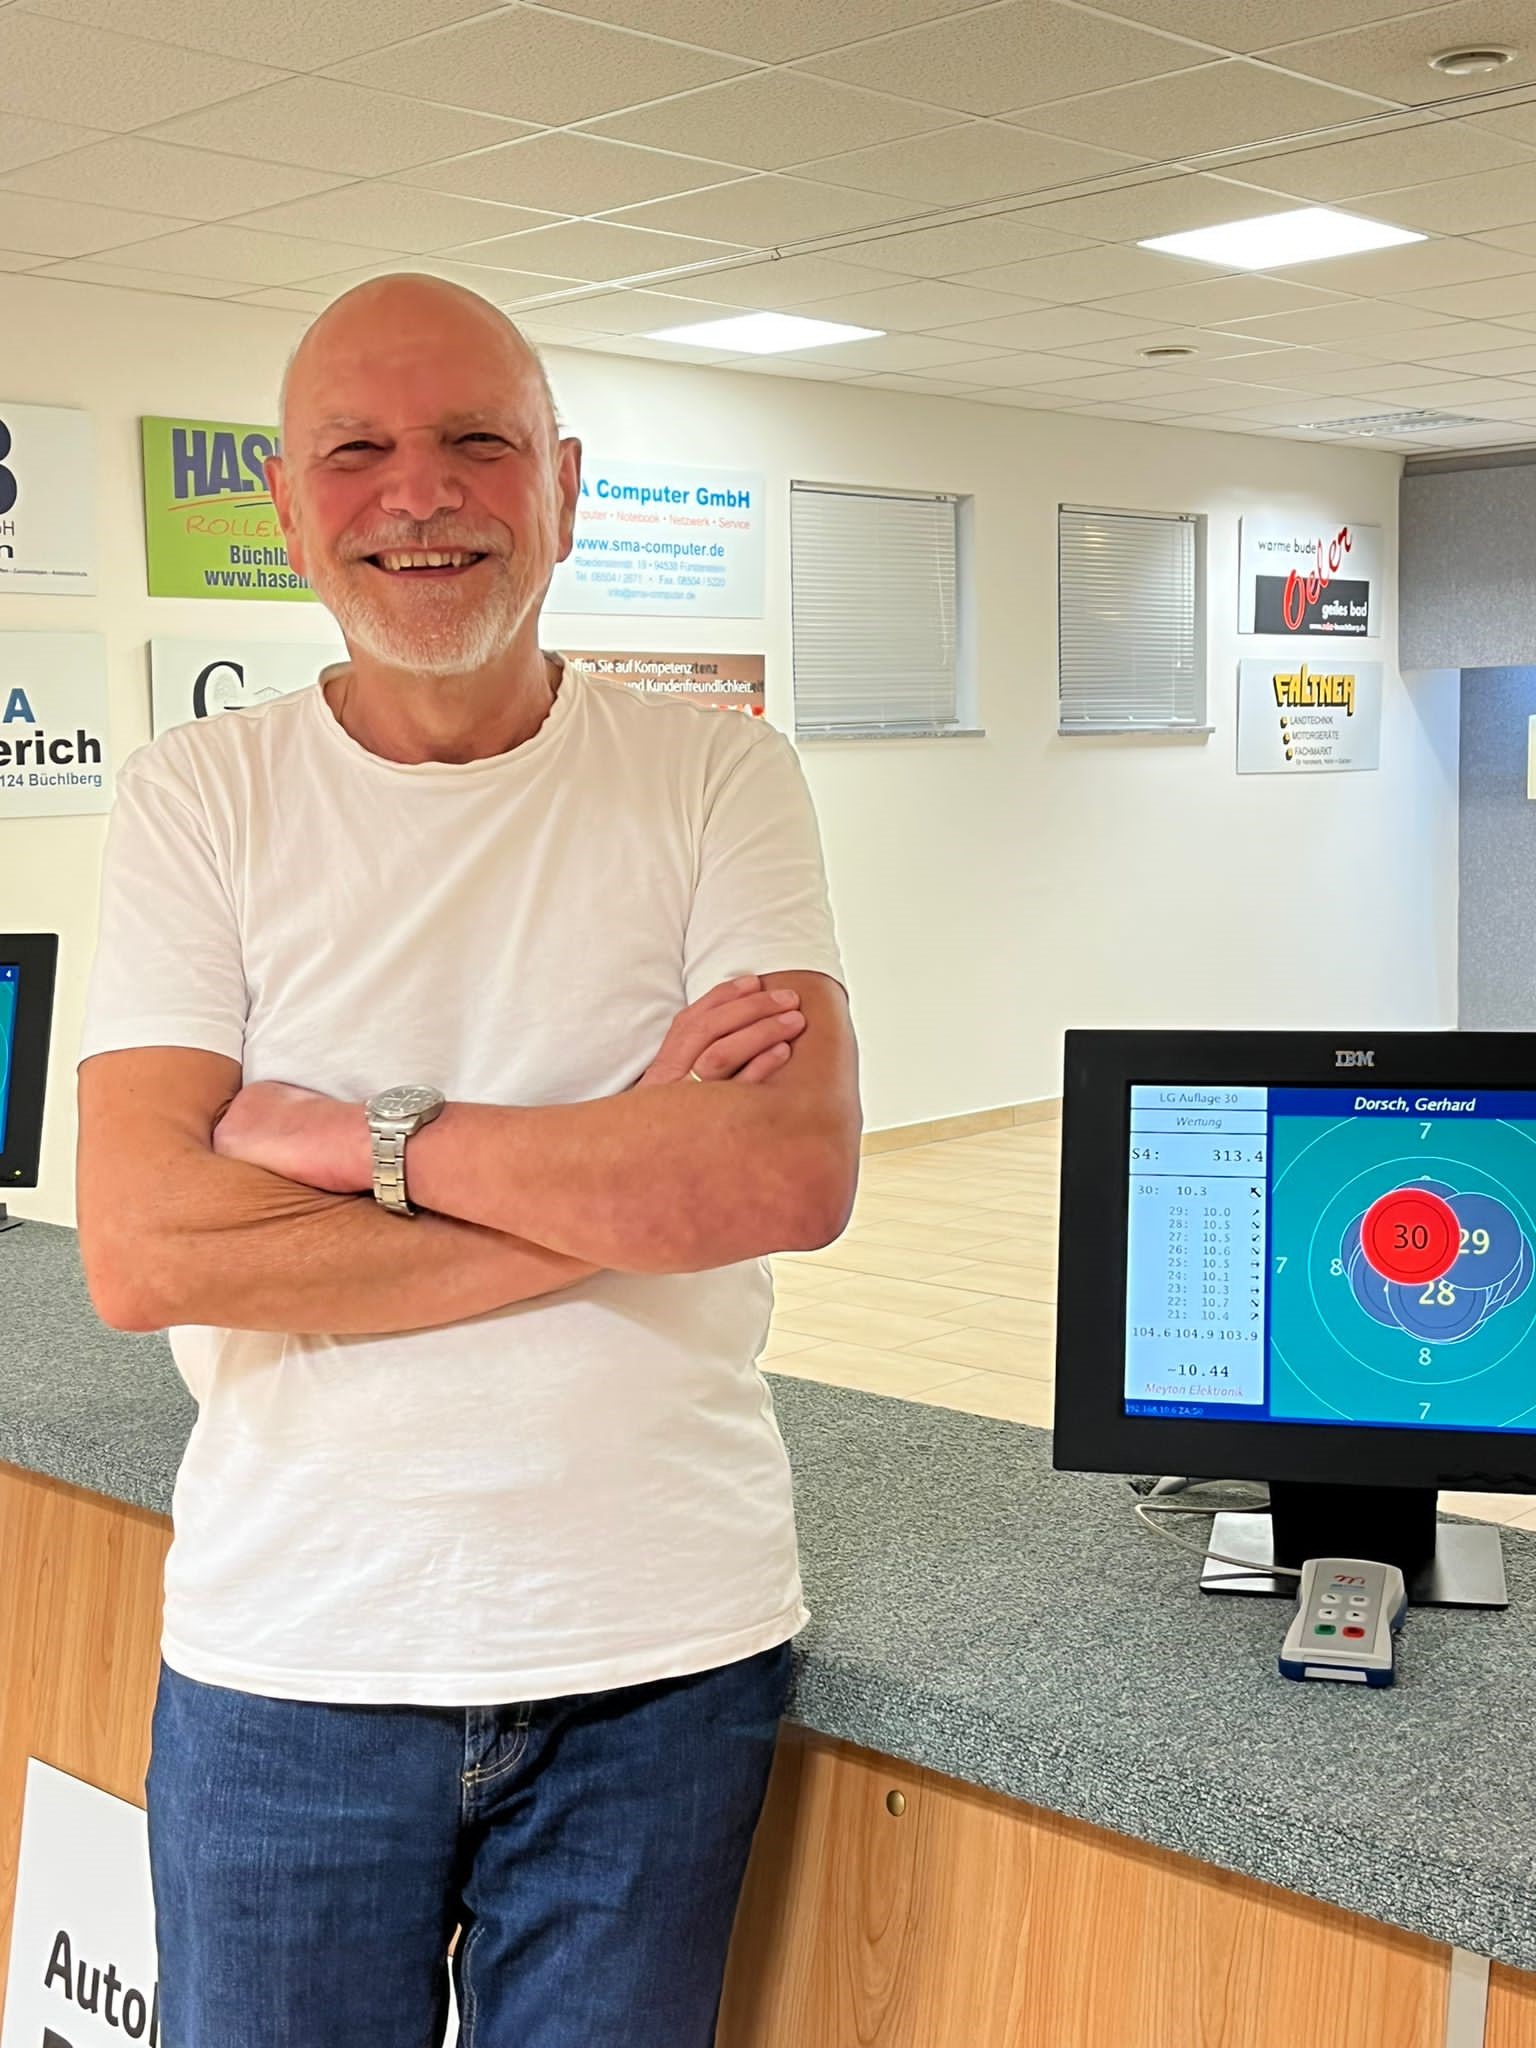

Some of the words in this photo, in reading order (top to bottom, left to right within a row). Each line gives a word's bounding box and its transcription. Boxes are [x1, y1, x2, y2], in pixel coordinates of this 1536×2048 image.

[172, 427, 282, 498] HAS
[597, 479, 690, 505] Computer
[696, 487, 751, 508] GmbH
[617, 511, 659, 523] Notebook
[670, 514, 710, 527] Netzwerk
[719, 517, 751, 530] Service
[575, 538, 725, 558] www.sma-computer.de
[1258, 540, 1291, 552] warme
[1294, 537, 1317, 555] bude
[204, 569, 312, 589] www.hasen
[597, 659, 615, 673] Sie
[615, 659, 633, 673] auf
[634, 660, 693, 676] Kompetenz
[1273, 663, 1356, 717] FALTNER
[2, 688, 36, 723] A
[29, 772, 102, 787] Büchlberg
[1335, 1050, 1375, 1067] IBM
[1159, 1093, 1176, 1103] LG
[1178, 1093, 1222, 1106] Auflage
[1224, 1094, 1239, 1104] 30
[1354, 1096, 1410, 1113] Dorsch,
[1414, 1097, 1476, 1113] Gerhard
[1176, 1117, 1223, 1129] Wertung
[1419, 1122, 1433, 1140] 7
[1131, 1148, 1160, 1161] S4:
[1212, 1150, 1264, 1163] 313.4
[1138, 1185, 1160, 1196] 30:
[1177, 1186, 1208, 1197] 10.3
[1204, 1207, 1231, 1217] 10.0
[1204, 1220, 1231, 1230] 10.5
[1204, 1233, 1231, 1243] 10.5
[1393, 1224, 1429, 1250] 30
[1459, 1228, 1490, 1256] 29
[1203, 1246, 1231, 1256] 10.6
[1203, 1259, 1230, 1269] 10.5
[1275, 1257, 1288, 1275] 7
[1330, 1258, 1343, 1277] 8
[1203, 1272, 1230, 1282] 10.1
[1202, 1285, 1229, 1295] 10.3
[1418, 1281, 1456, 1306] 28
[1202, 1298, 1229, 1308] 10.7
[1202, 1311, 1229, 1321] 10.4
[1133, 1327, 1171, 1337] 104.6
[1176, 1328, 1214, 1339] 104.9
[1219, 1330, 1258, 1341] 103.9
[1418, 1347, 1432, 1366] 8
[1145, 1384, 1186, 1395] Meyton
[1188, 1384, 1243, 1396] Elektronik
[1418, 1402, 1432, 1421] 7
